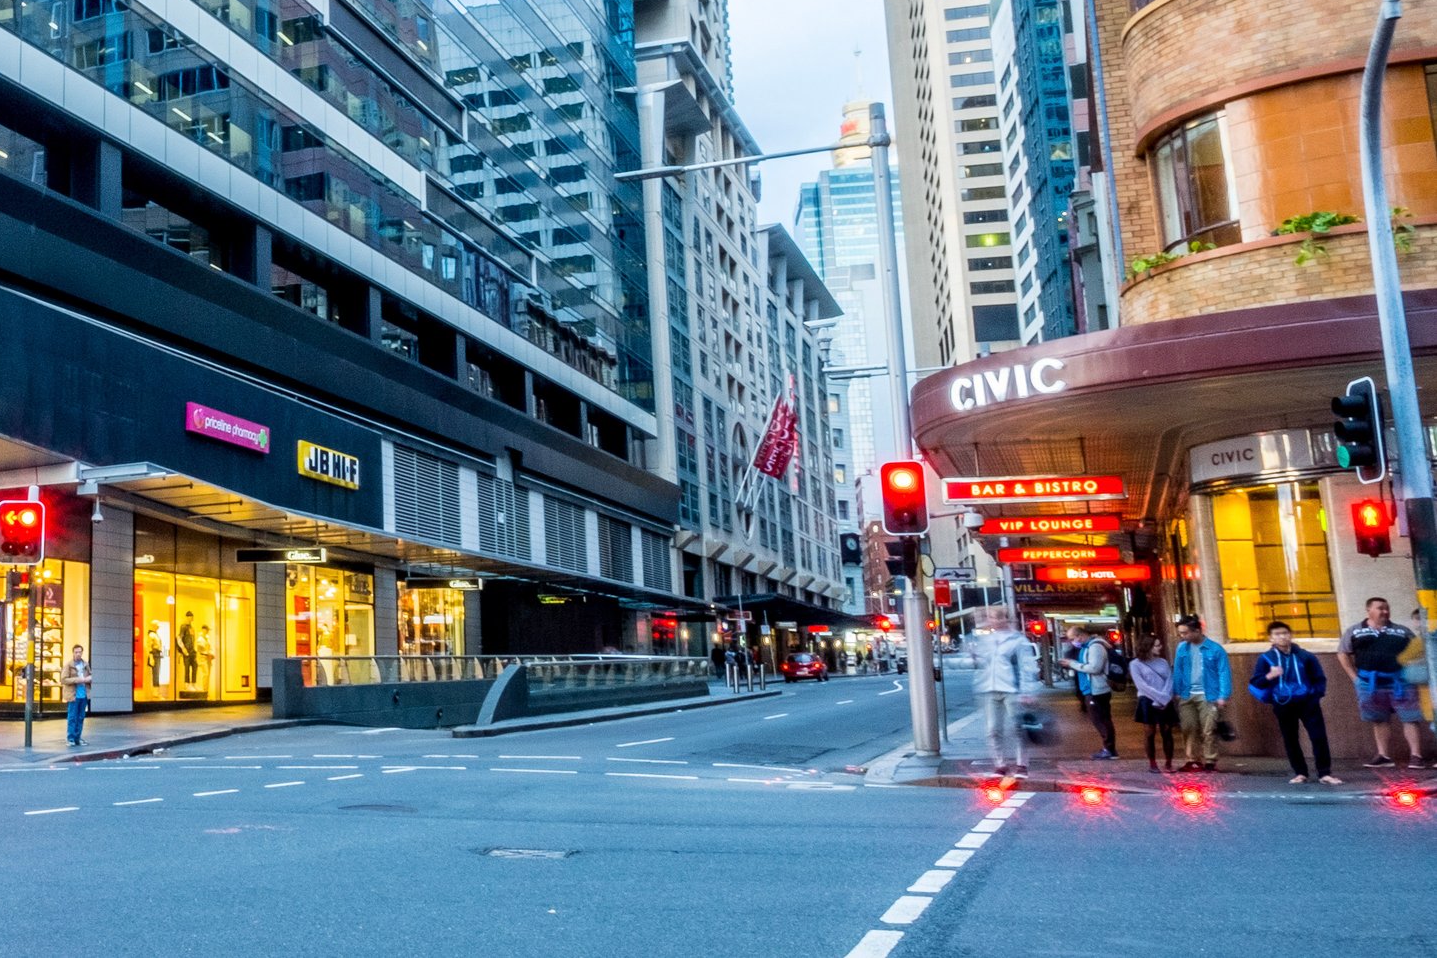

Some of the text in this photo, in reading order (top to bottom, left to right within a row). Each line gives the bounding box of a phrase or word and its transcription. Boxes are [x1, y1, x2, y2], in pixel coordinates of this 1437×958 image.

[950, 357, 1067, 411] CIVIC
[204, 416, 259, 445] priceline pharmacy
[308, 446, 330, 475] JB
[1211, 448, 1254, 465] CIVIC
[971, 480, 1098, 496] BAR & BISTRO
[999, 518, 1093, 531] VIP LOUNGE
[1022, 549, 1096, 560] PEPPERCORN
[1014, 584, 1104, 593] VILLA HOTEL
